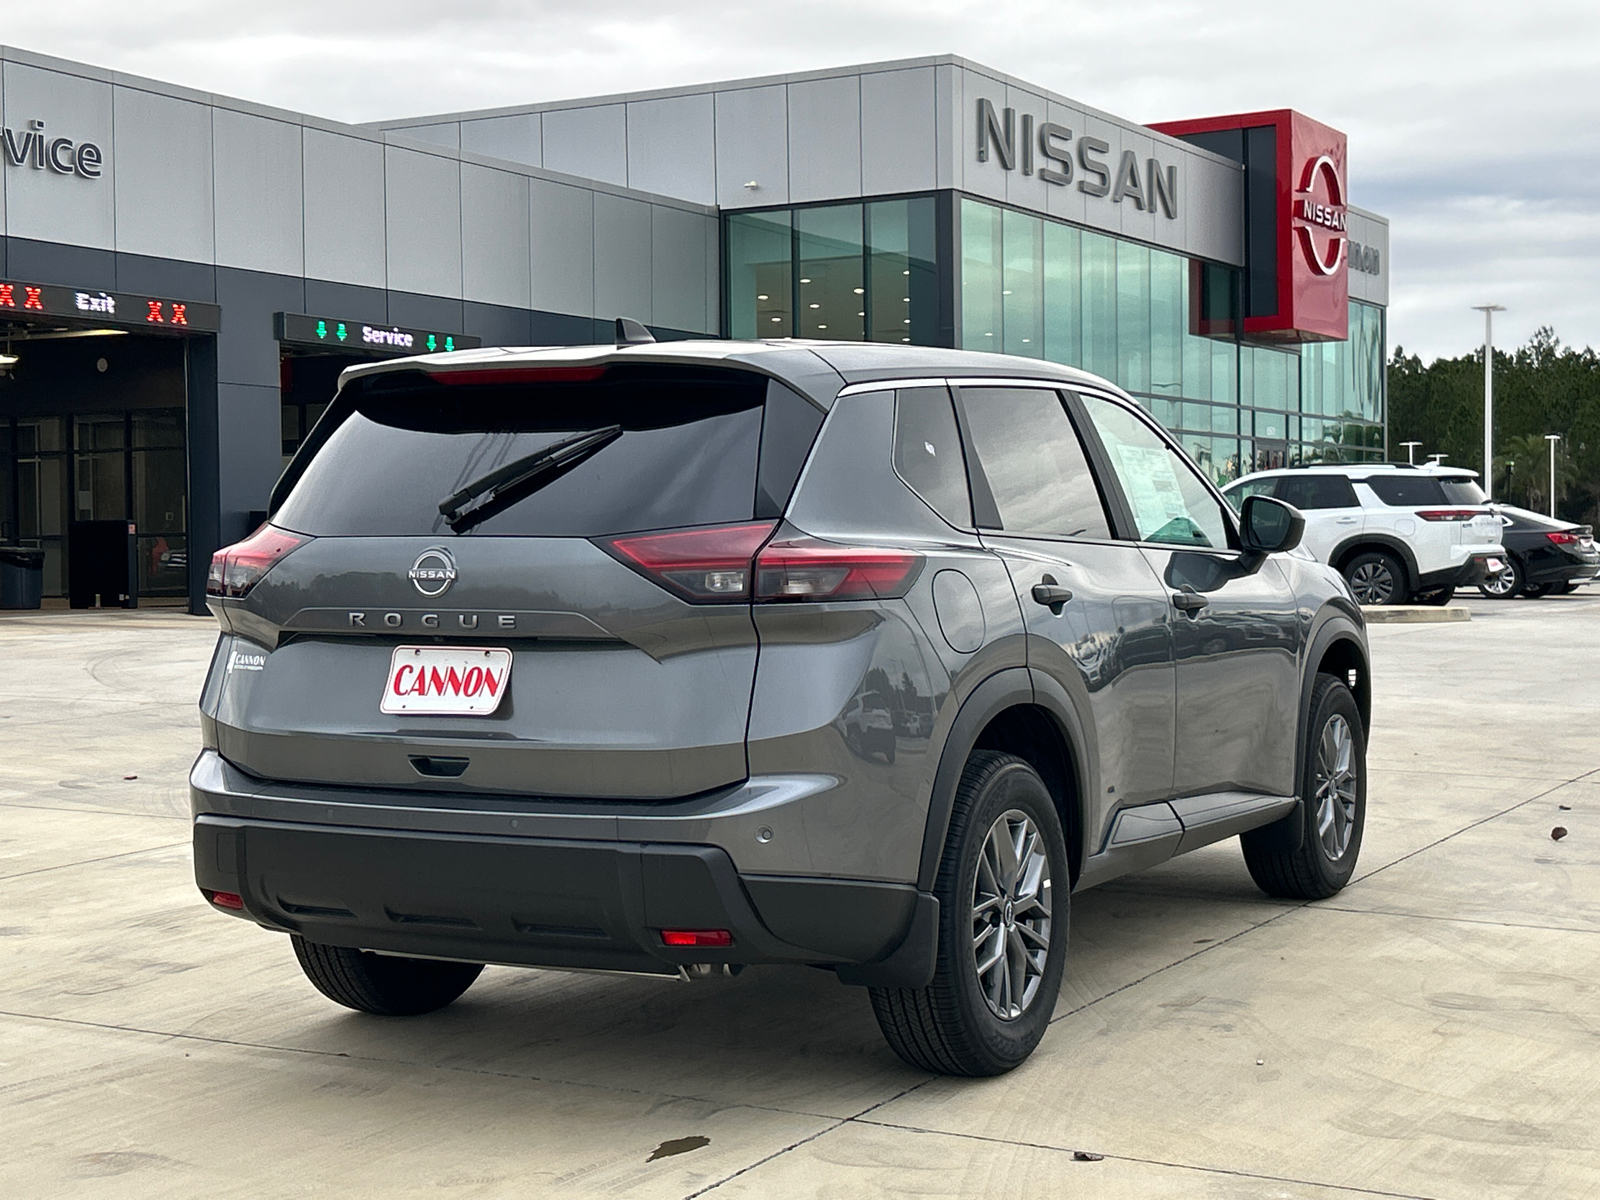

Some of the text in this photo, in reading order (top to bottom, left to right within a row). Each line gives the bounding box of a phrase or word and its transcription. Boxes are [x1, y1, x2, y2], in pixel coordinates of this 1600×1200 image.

[0, 119, 103, 179] vice
[976, 97, 1177, 220] NISSAN
[1303, 199, 1347, 232] NISSAN
[75, 292, 116, 314] Exit
[362, 325, 414, 347] Service
[408, 569, 456, 579] NISSAN
[348, 612, 517, 629] ROGUE
[393, 664, 503, 698] CANNON
